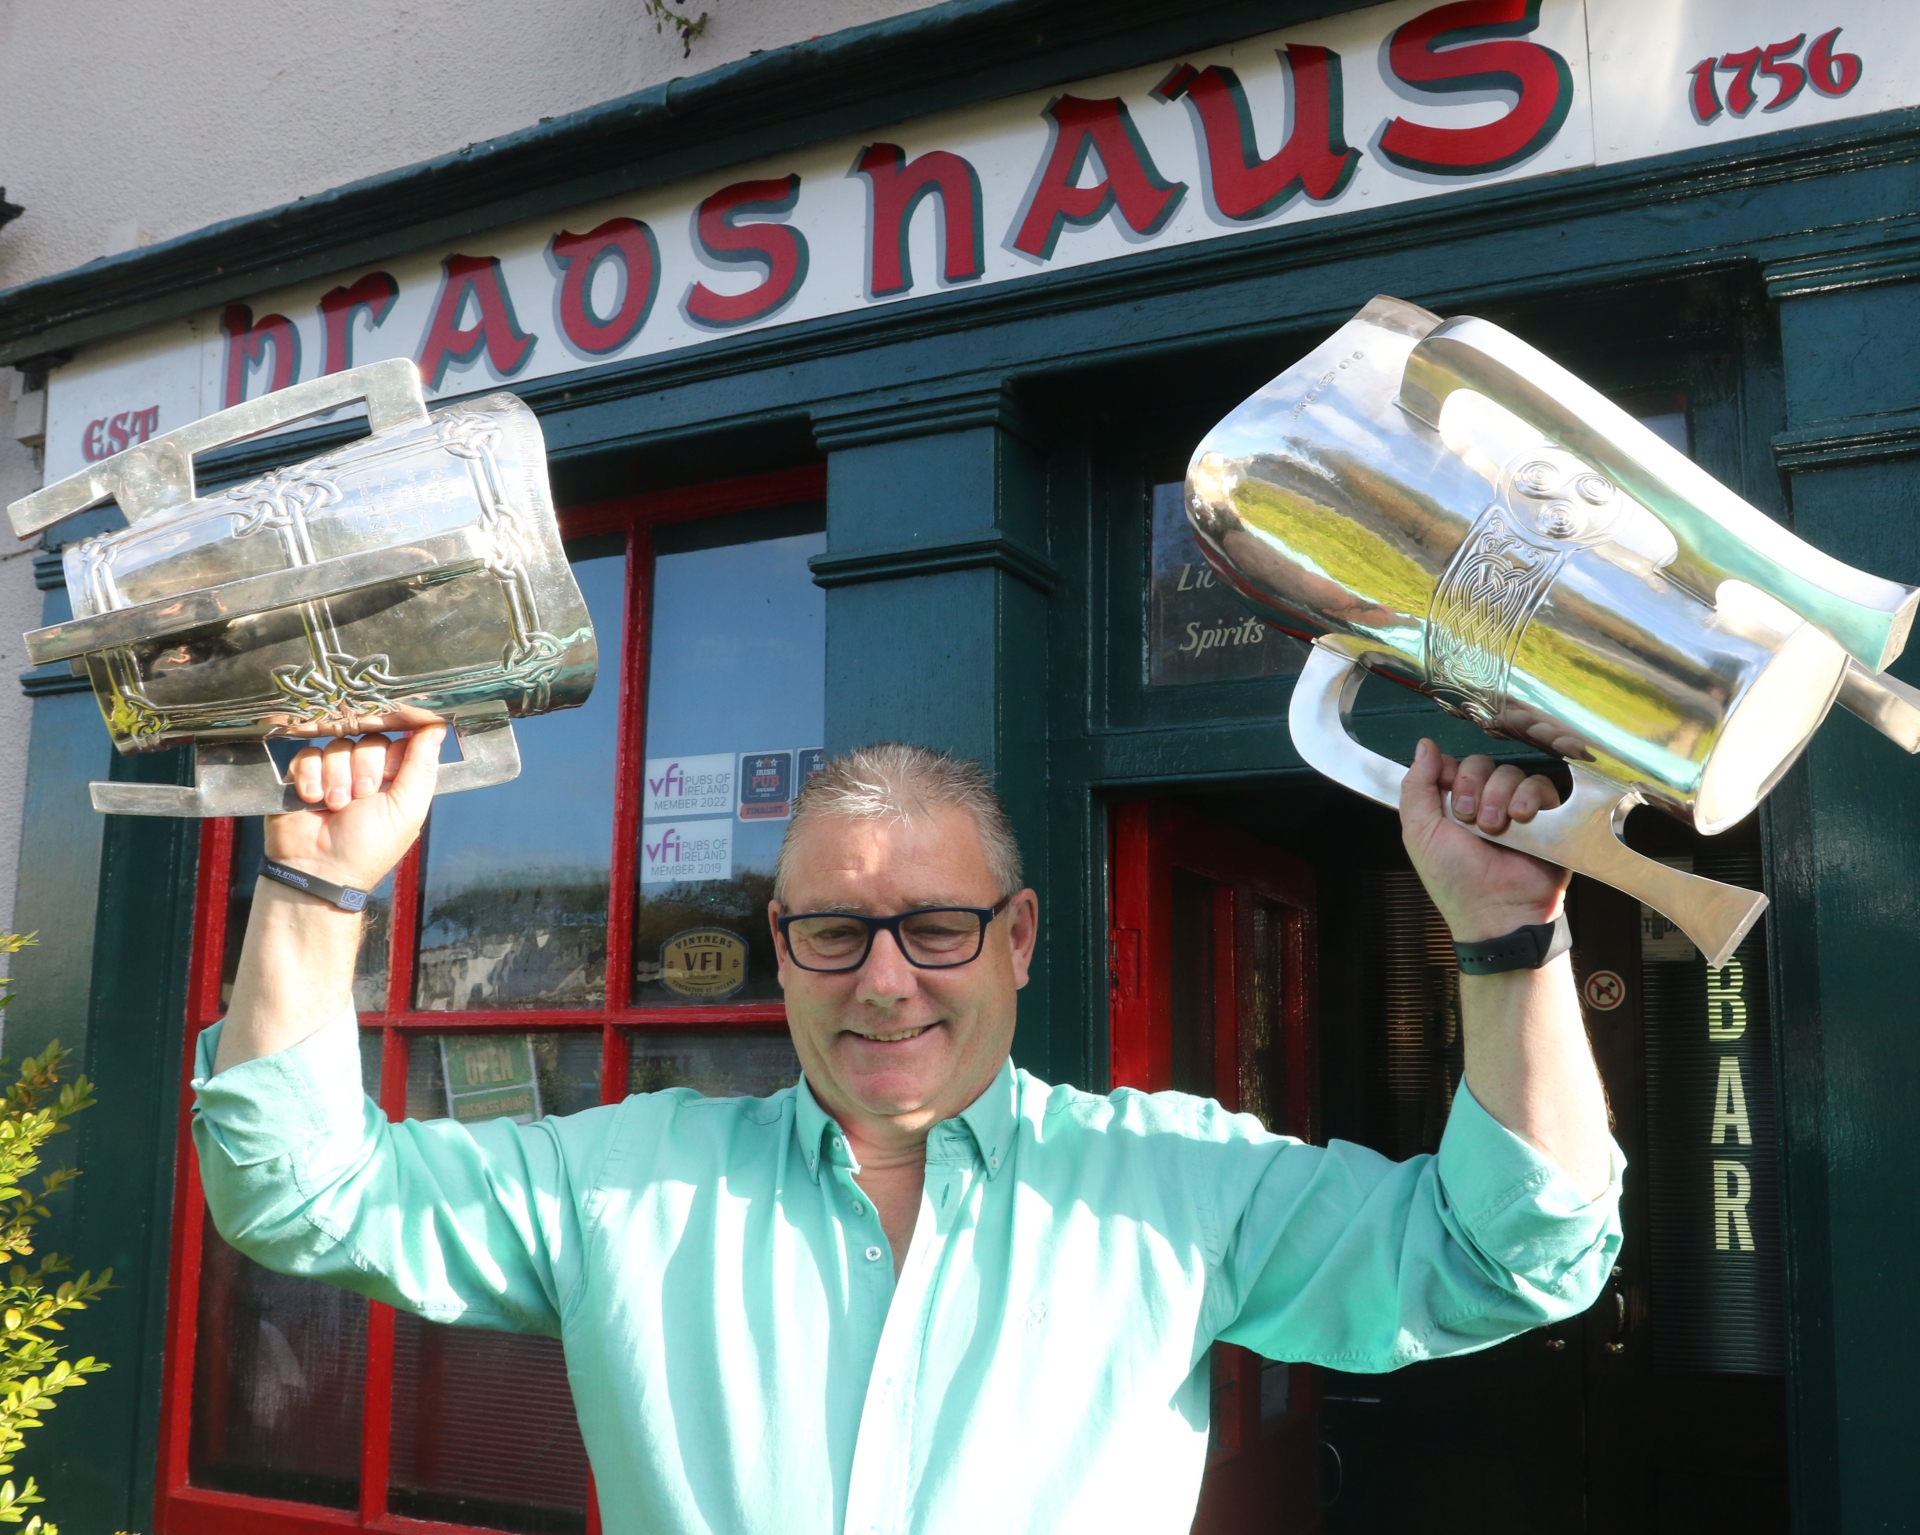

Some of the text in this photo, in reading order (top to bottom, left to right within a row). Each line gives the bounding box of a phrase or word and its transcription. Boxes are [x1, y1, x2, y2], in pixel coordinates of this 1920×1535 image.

[1687, 26, 1863, 127] 1756
[82, 404, 160, 463] EST
[1179, 615, 1265, 659] Spirits
[648, 763, 685, 798] vfi
[685, 773, 731, 786] PUBS OF
[752, 776, 780, 788] PUB
[684, 784, 730, 797] IRELAND
[654, 796, 727, 811] MEMBER 2022
[746, 806, 783, 814] FINALIST
[645, 828, 681, 864] vfi
[682, 838, 728, 852] PUBS OF
[681, 849, 727, 863] IRELAND
[651, 863, 722, 877] MEMBER 2019
[675, 936, 733, 949] VINTNERS
[684, 952, 722, 971] VFI
[465, 1047, 513, 1085] OPEN
[458, 1095, 530, 1118] BUSINESS HOURS
[1706, 955, 1756, 1252] BAR
